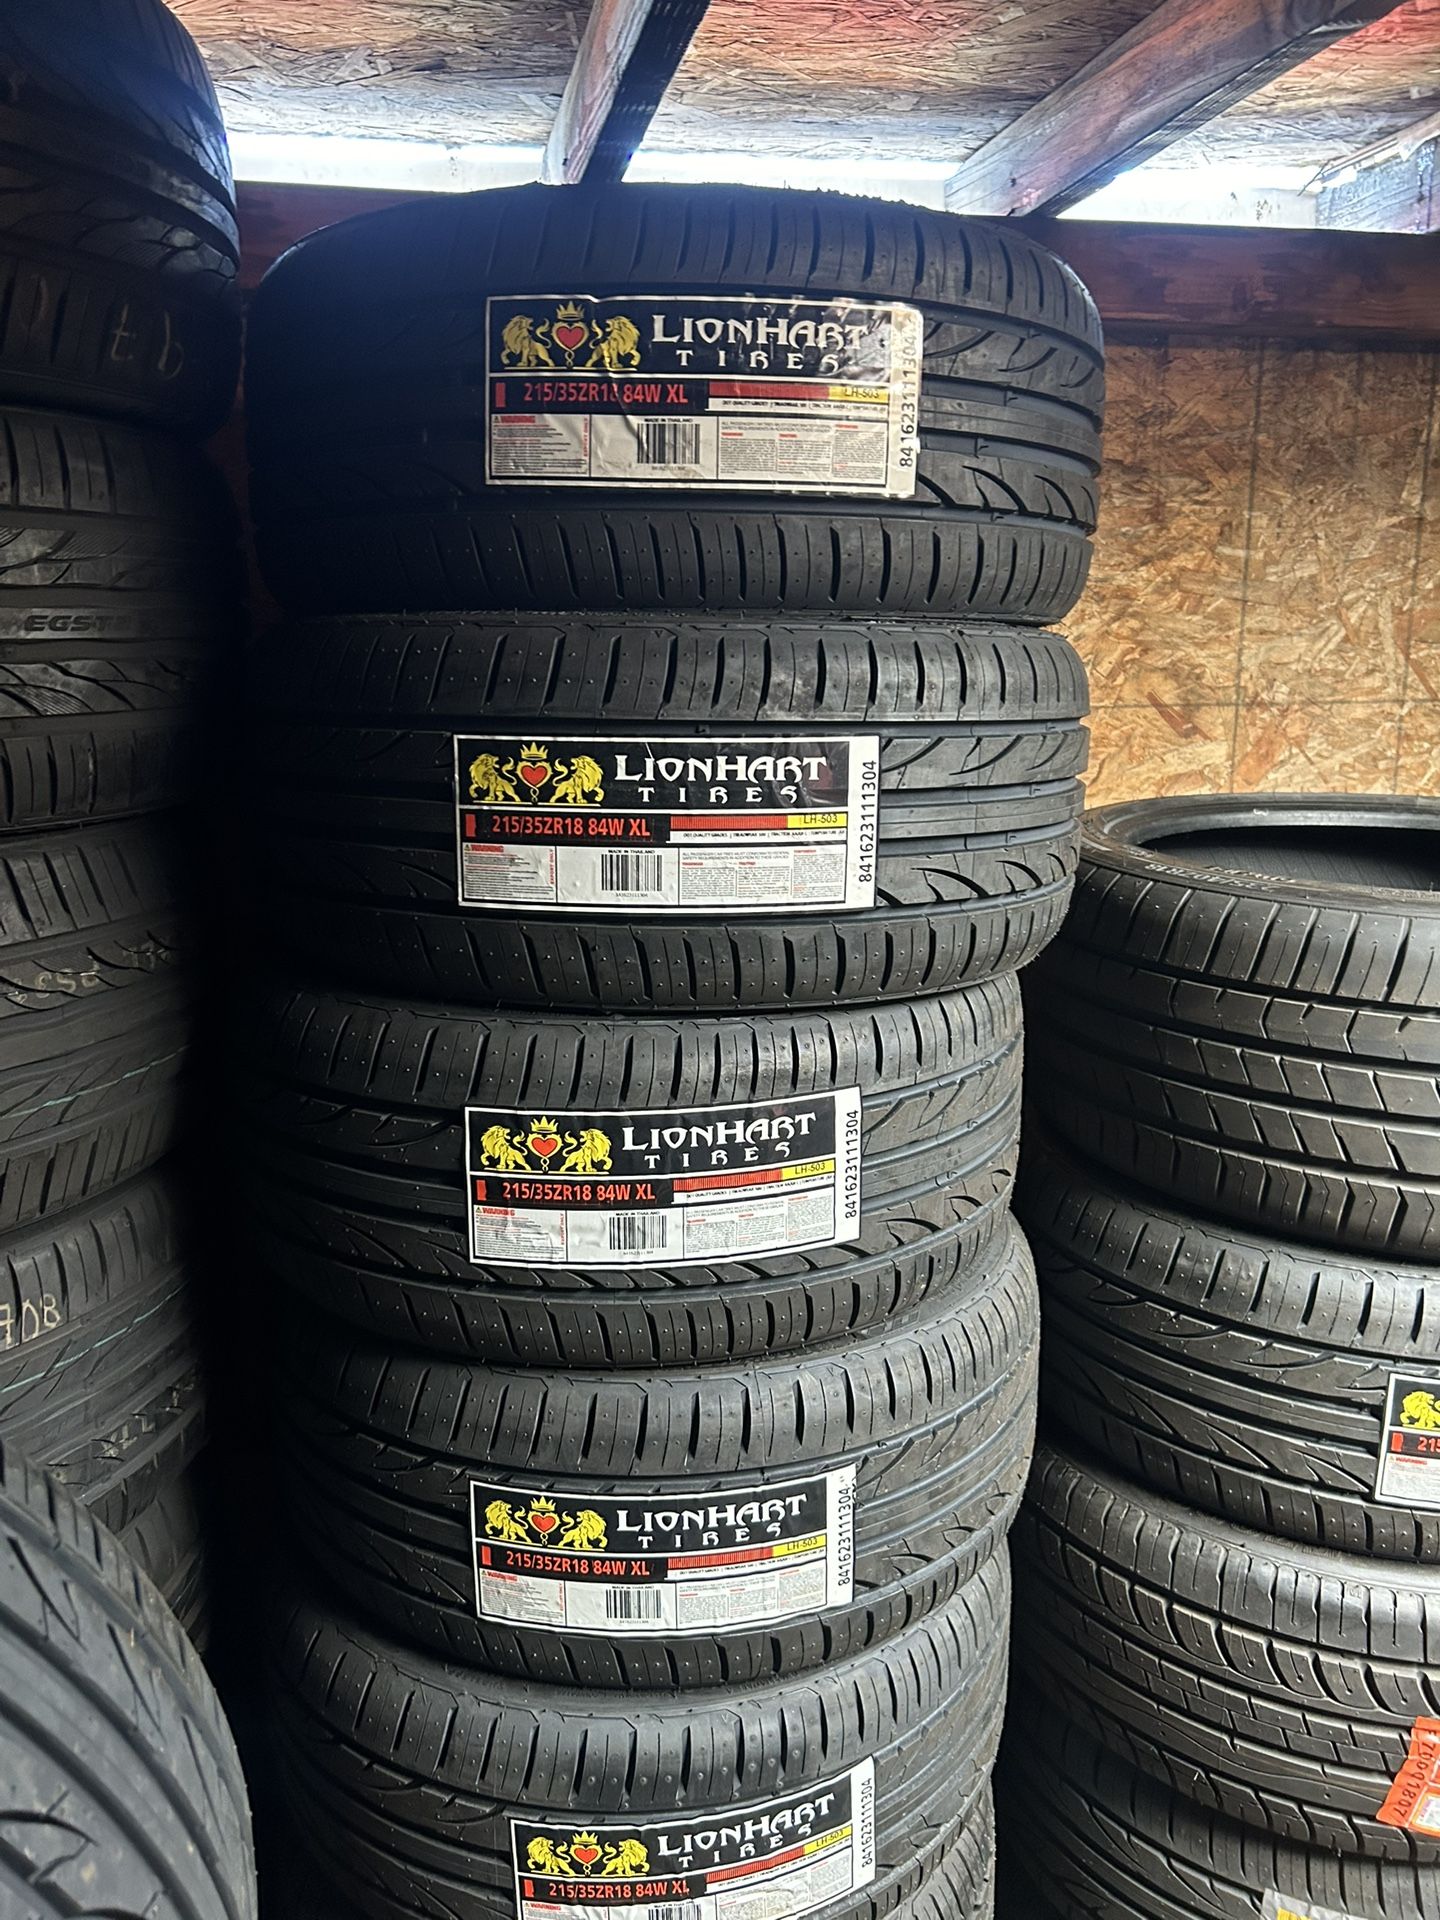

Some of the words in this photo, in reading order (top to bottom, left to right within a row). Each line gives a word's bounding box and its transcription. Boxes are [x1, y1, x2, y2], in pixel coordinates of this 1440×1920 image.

[651, 314, 869, 351] LIONHART
[676, 349, 840, 372] TIRES
[623, 384, 661, 404] 84W
[666, 384, 689, 404] XL
[614, 755, 827, 783] LIONHART
[637, 786, 800, 804] TIRES
[492, 815, 584, 836] 215/35ZR18
[588, 818, 624, 836] 84W
[629, 819, 651, 837] XL
[803, 814, 838, 825] LH-503
[858, 760, 877, 883] 841623111304
[622, 1112, 817, 1151] LIONHART
[644, 1141, 790, 1169] TIRES
[845, 1110, 859, 1219] 841623111304
[794, 1163, 826, 1175] LH-503
[502, 1182, 592, 1201] 215/35ZR18
[597, 1183, 631, 1201] 84W
[635, 1183, 656, 1200] XL
[616, 1493, 807, 1532] LIONHART
[637, 1522, 782, 1549] TIRES
[786, 1538, 818, 1551] LH-503
[837, 1487, 851, 1586] 841623111304
[506, 1550, 589, 1574] 215/35ZR18
[593, 1560, 626, 1576] 84W
[630, 1560, 650, 1576] XL
[657, 1793, 835, 1856] LIONHART
[861, 1778, 873, 1867] 841623111304
[678, 1823, 812, 1868] TIRES
[549, 1883, 632, 1898] 215/35ZR18
[636, 1882, 668, 1897] 84W
[672, 1880, 690, 1895] XL
